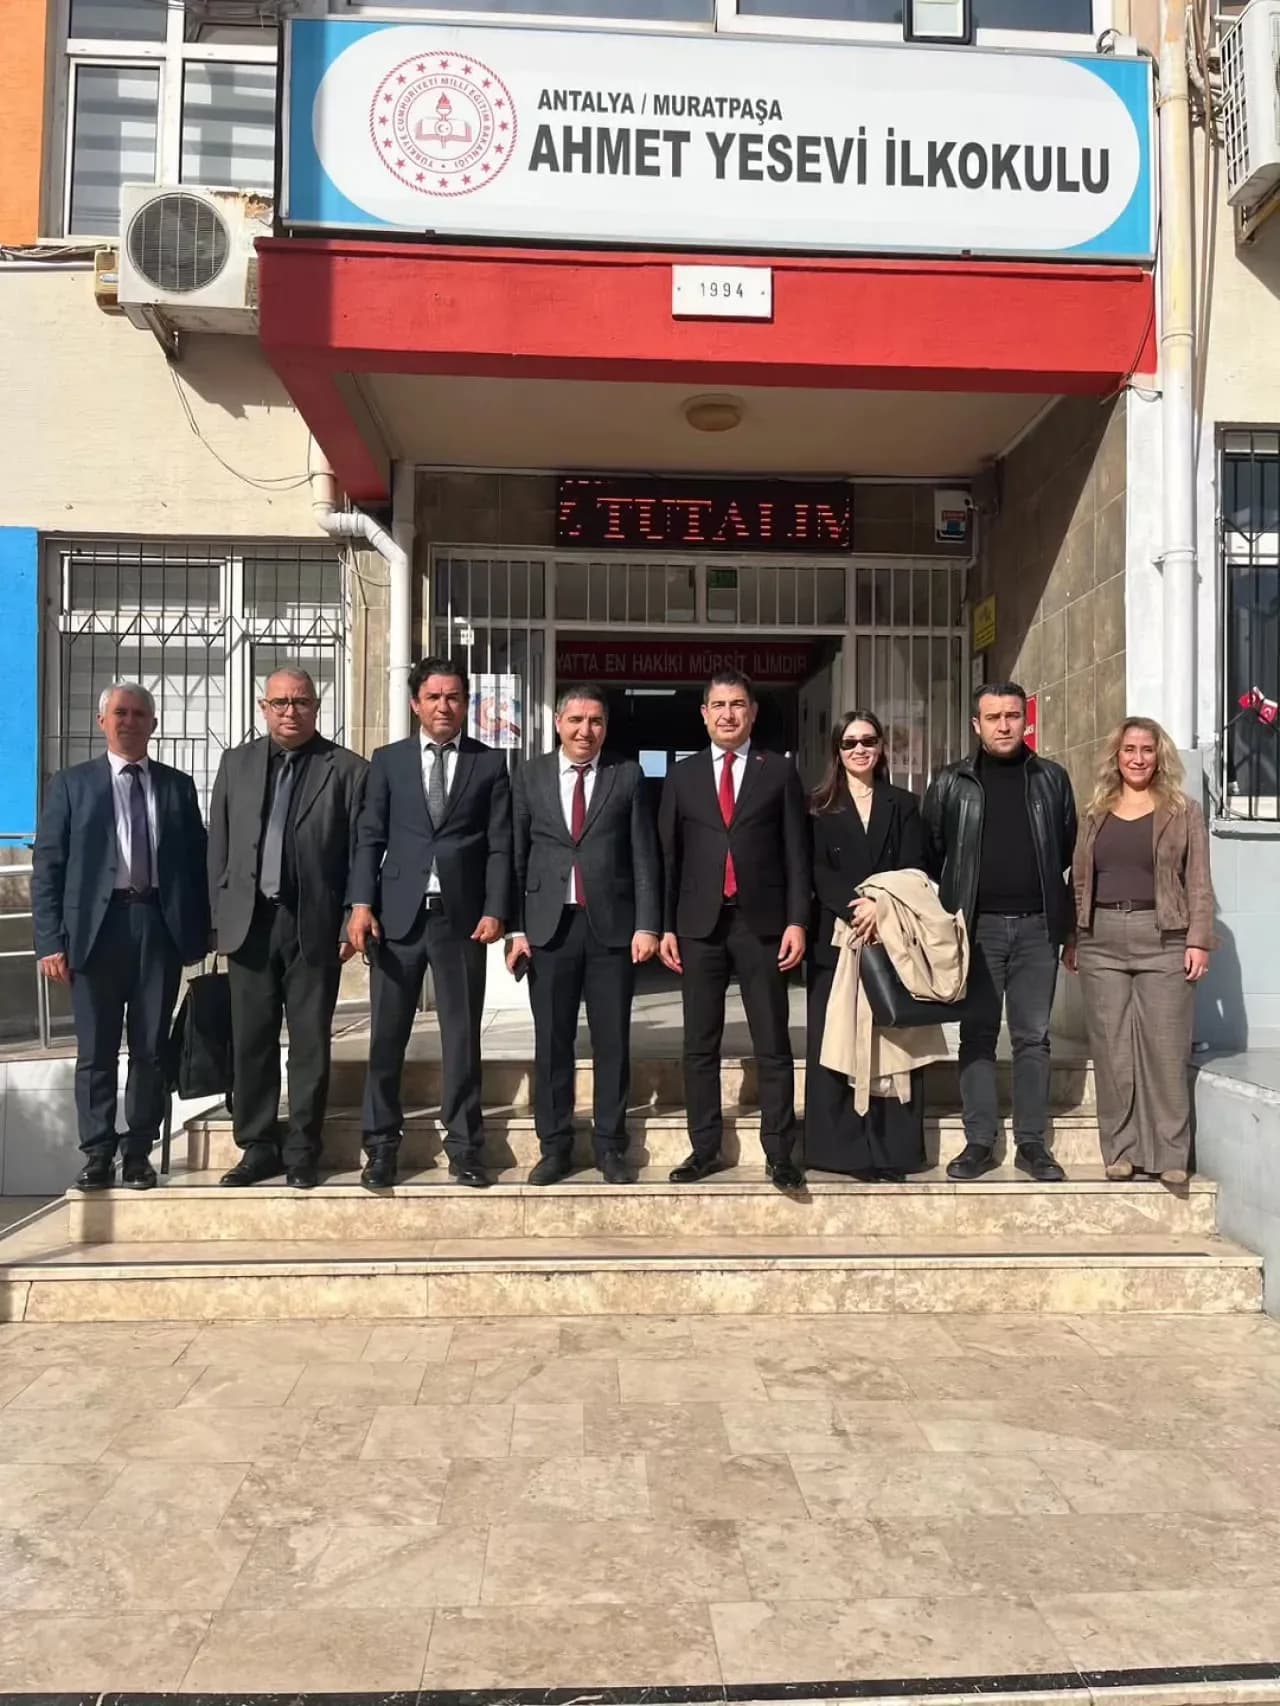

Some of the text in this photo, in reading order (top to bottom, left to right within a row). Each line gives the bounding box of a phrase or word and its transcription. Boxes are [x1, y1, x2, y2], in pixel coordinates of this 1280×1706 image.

[538, 88, 635, 115] ANTALYA
[653, 94, 783, 126] MURATPAŞA
[528, 124, 1110, 194] AHMET YESEVİ İLKOKULU
[700, 281, 744, 298] 1994
[605, 653, 626, 673] EN
